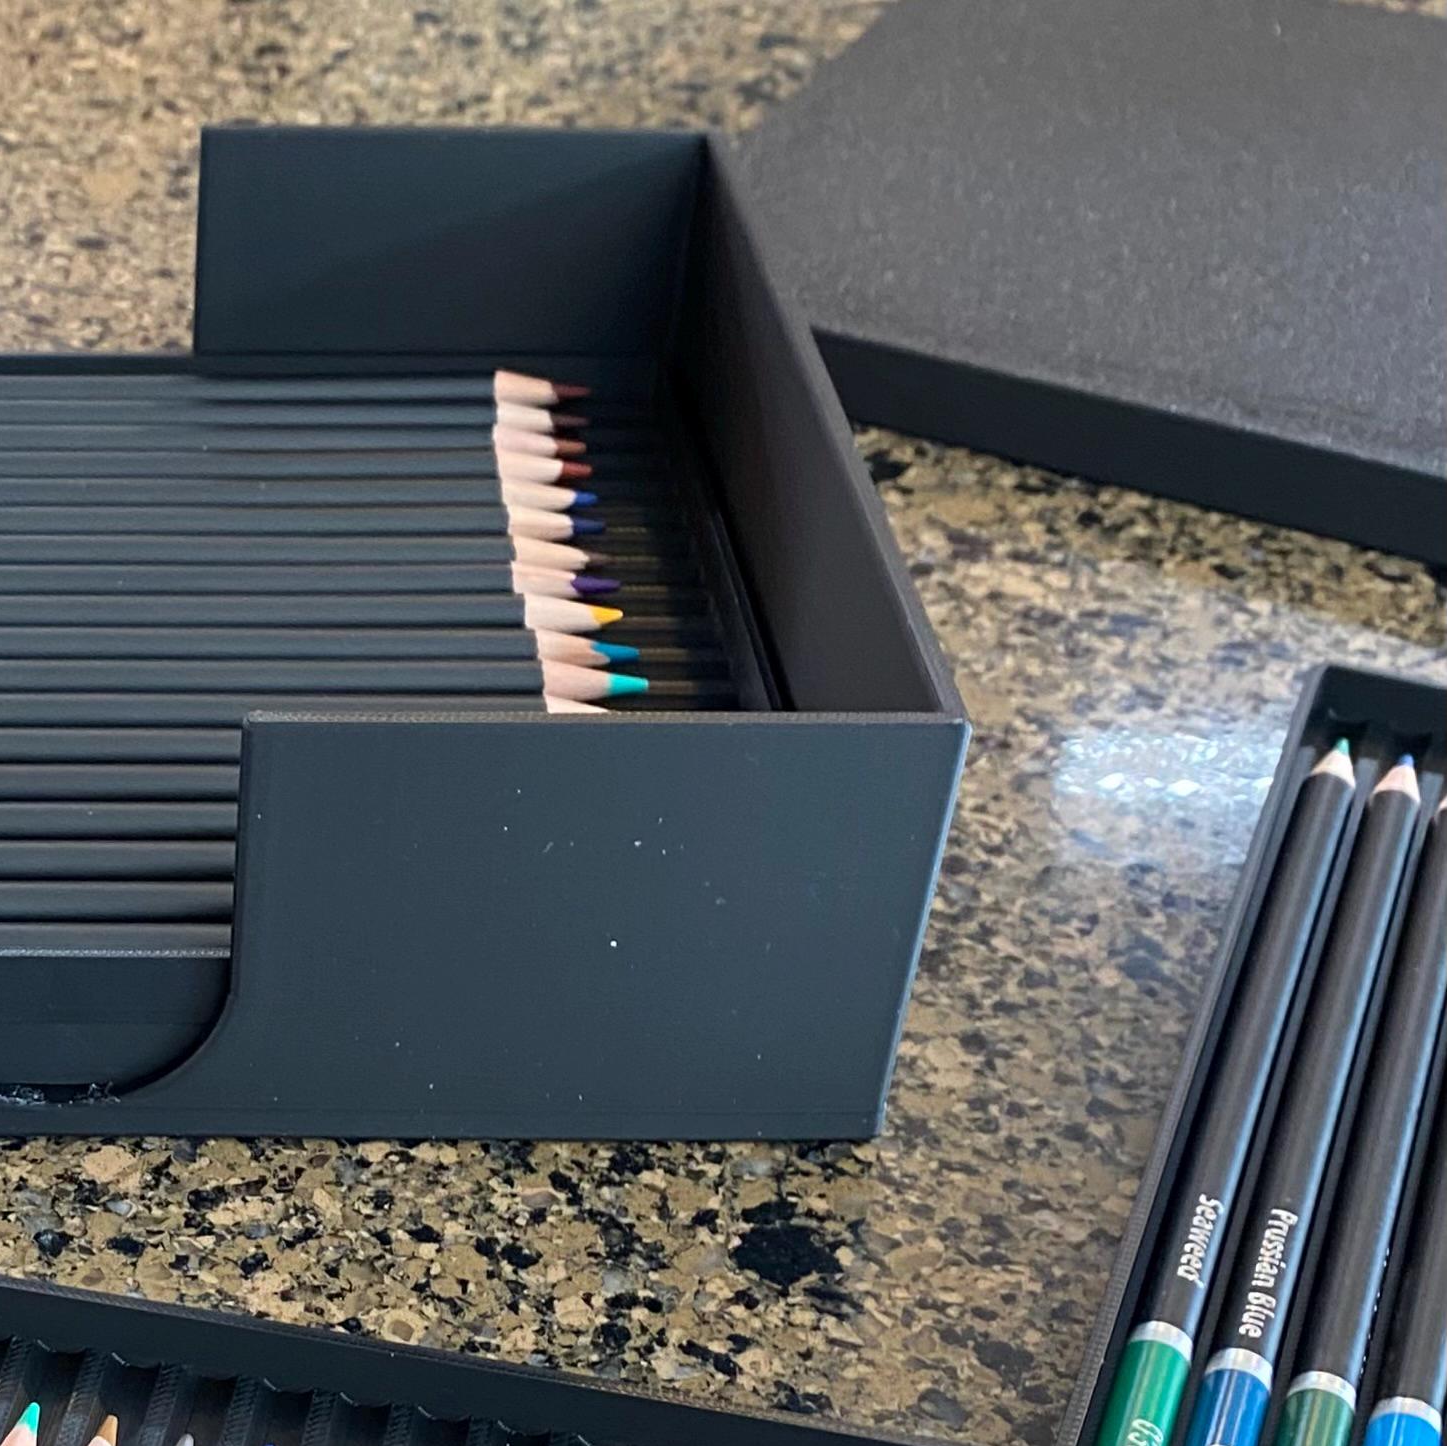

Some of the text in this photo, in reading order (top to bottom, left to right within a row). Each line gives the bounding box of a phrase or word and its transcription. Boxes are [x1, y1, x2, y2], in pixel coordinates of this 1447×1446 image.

[1177, 1194, 1224, 1286] Seaweed
[1238, 1208, 1299, 1339] Prussian Blue
